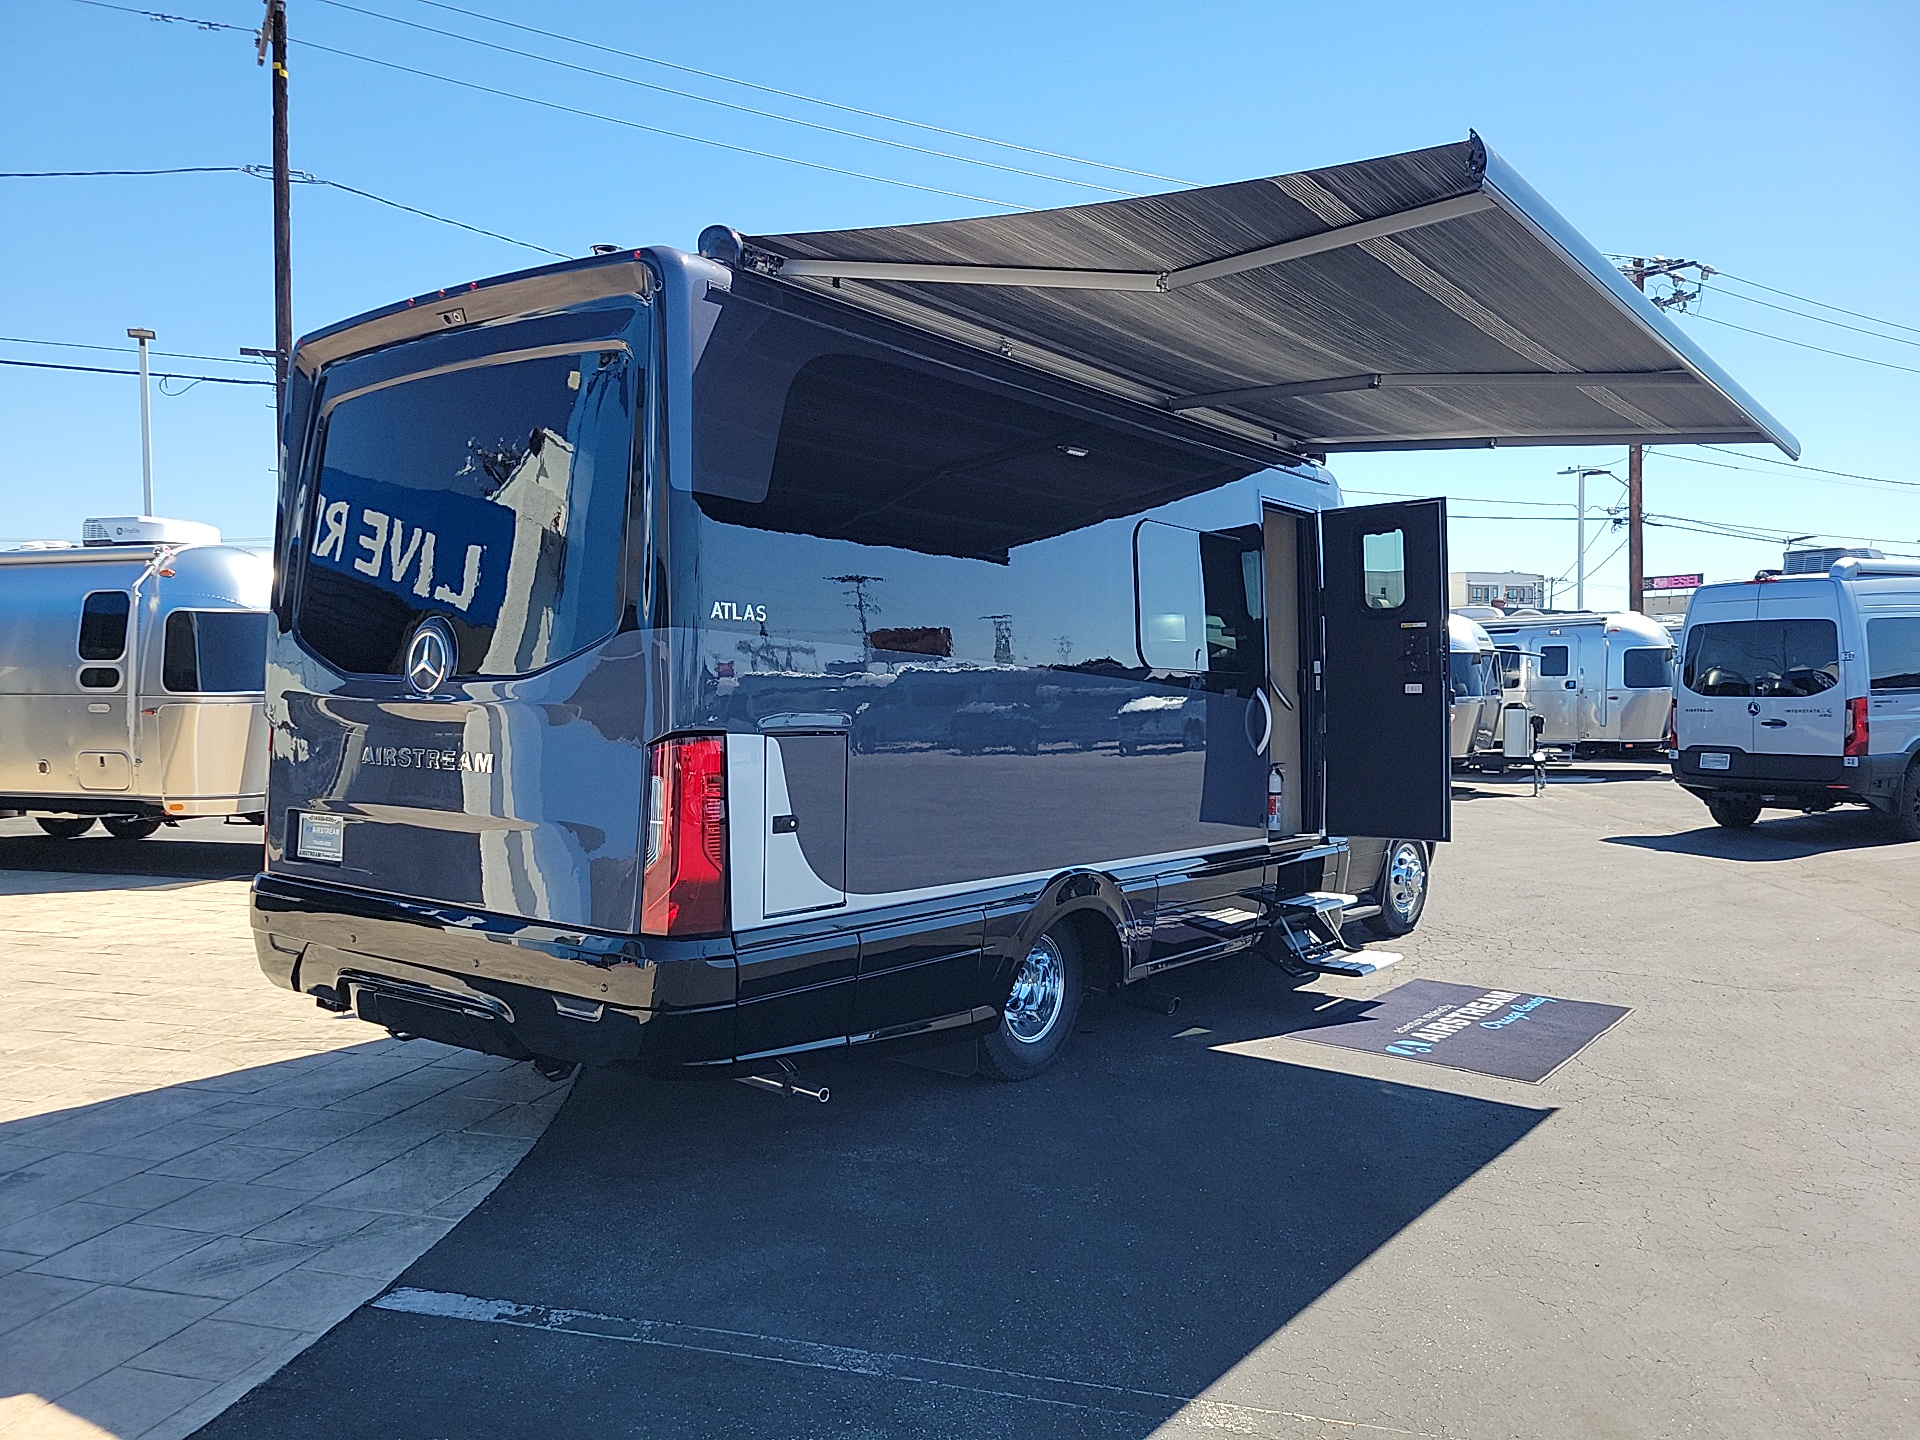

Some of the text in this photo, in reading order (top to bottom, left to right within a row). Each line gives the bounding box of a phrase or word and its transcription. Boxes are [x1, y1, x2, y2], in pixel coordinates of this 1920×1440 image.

[710, 600, 767, 622] ATLAS
[361, 746, 494, 774] AIRSTREAM
[1410, 990, 1522, 1043] AIRSTREAM
